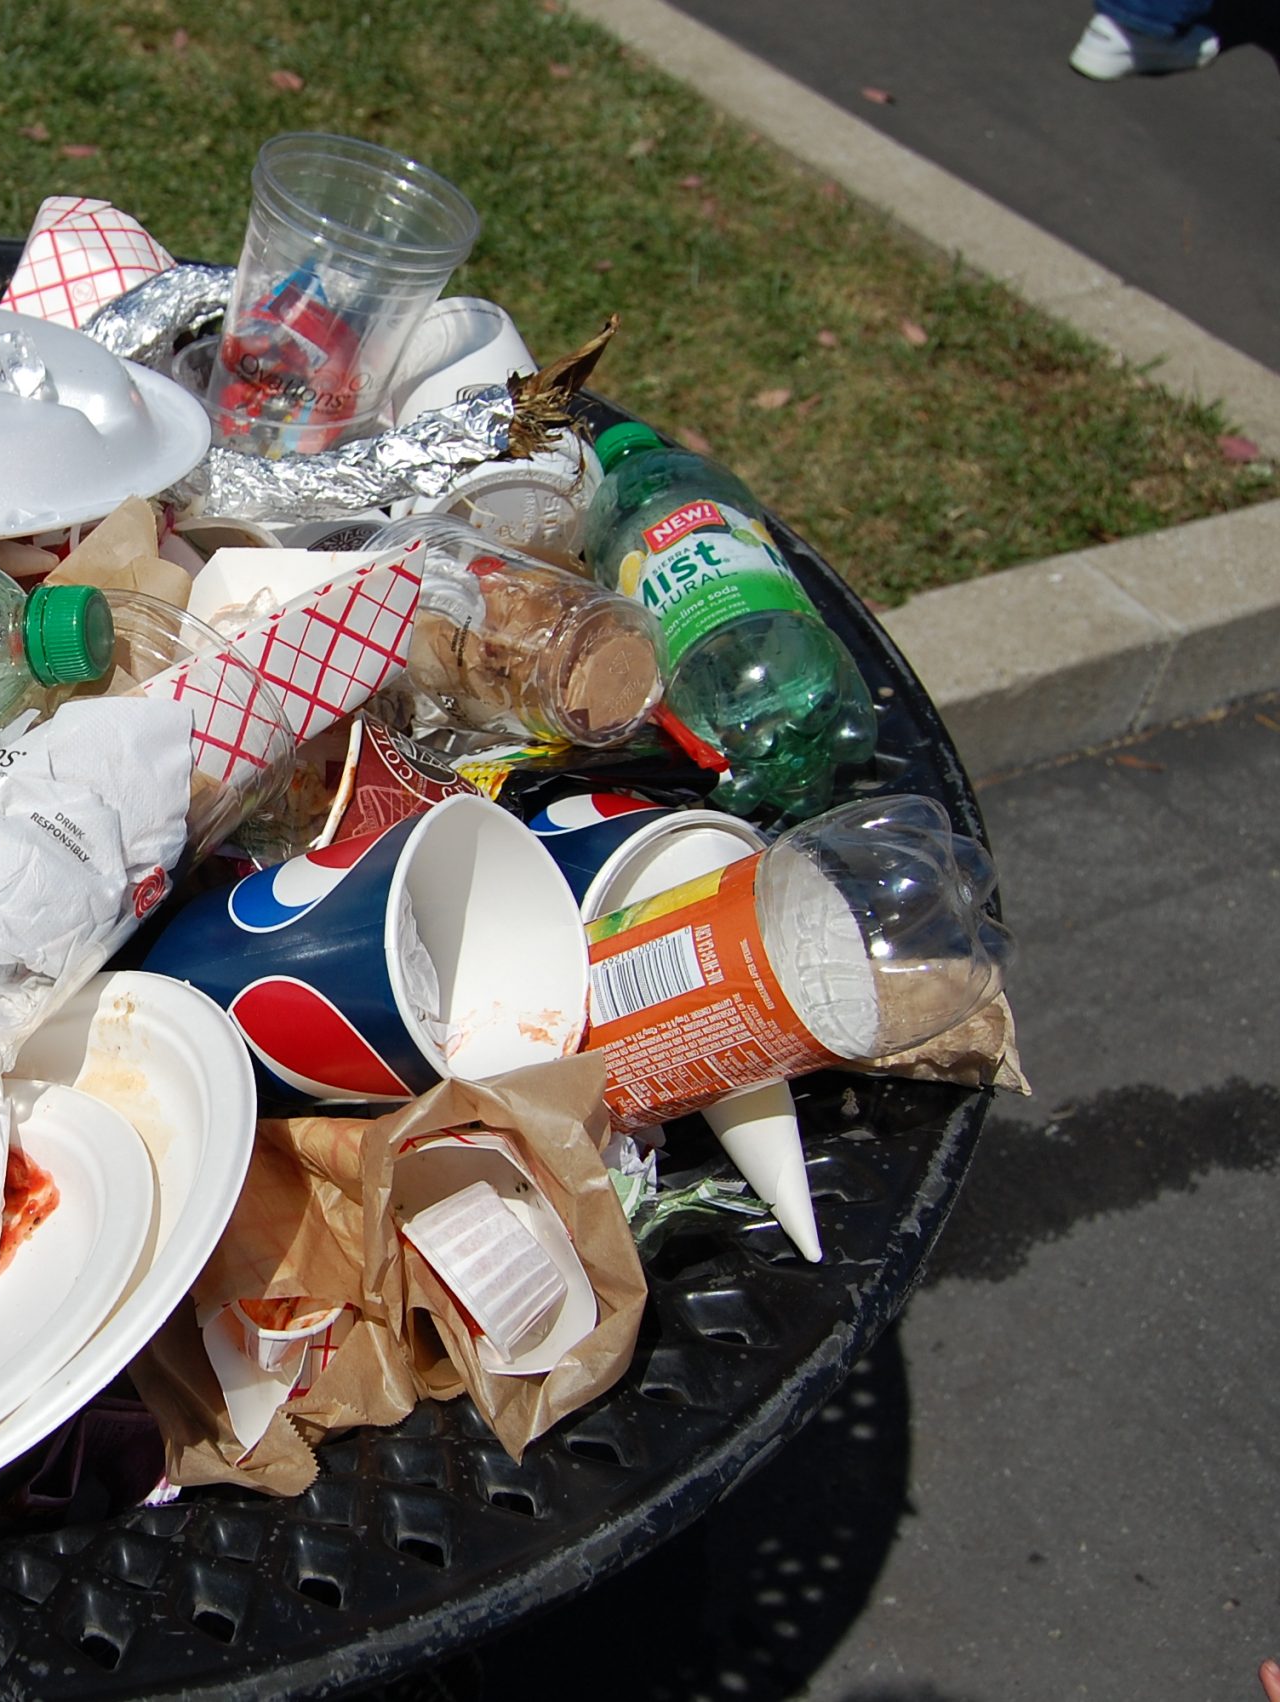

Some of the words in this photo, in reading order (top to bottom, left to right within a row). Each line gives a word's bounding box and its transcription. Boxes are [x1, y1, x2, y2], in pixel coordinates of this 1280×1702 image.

[240, 353, 345, 409] Ovations
[652, 504, 712, 543] NEW!
[651, 547, 690, 575] SIERRA
[656, 568, 730, 622] TURAL
[707, 584, 739, 601] soda
[29, 811, 91, 863] RESPONSIBLY
[54, 811, 86, 840] DRINK
[638, 934, 670, 952] 12000
[601, 949, 635, 970] 01269
